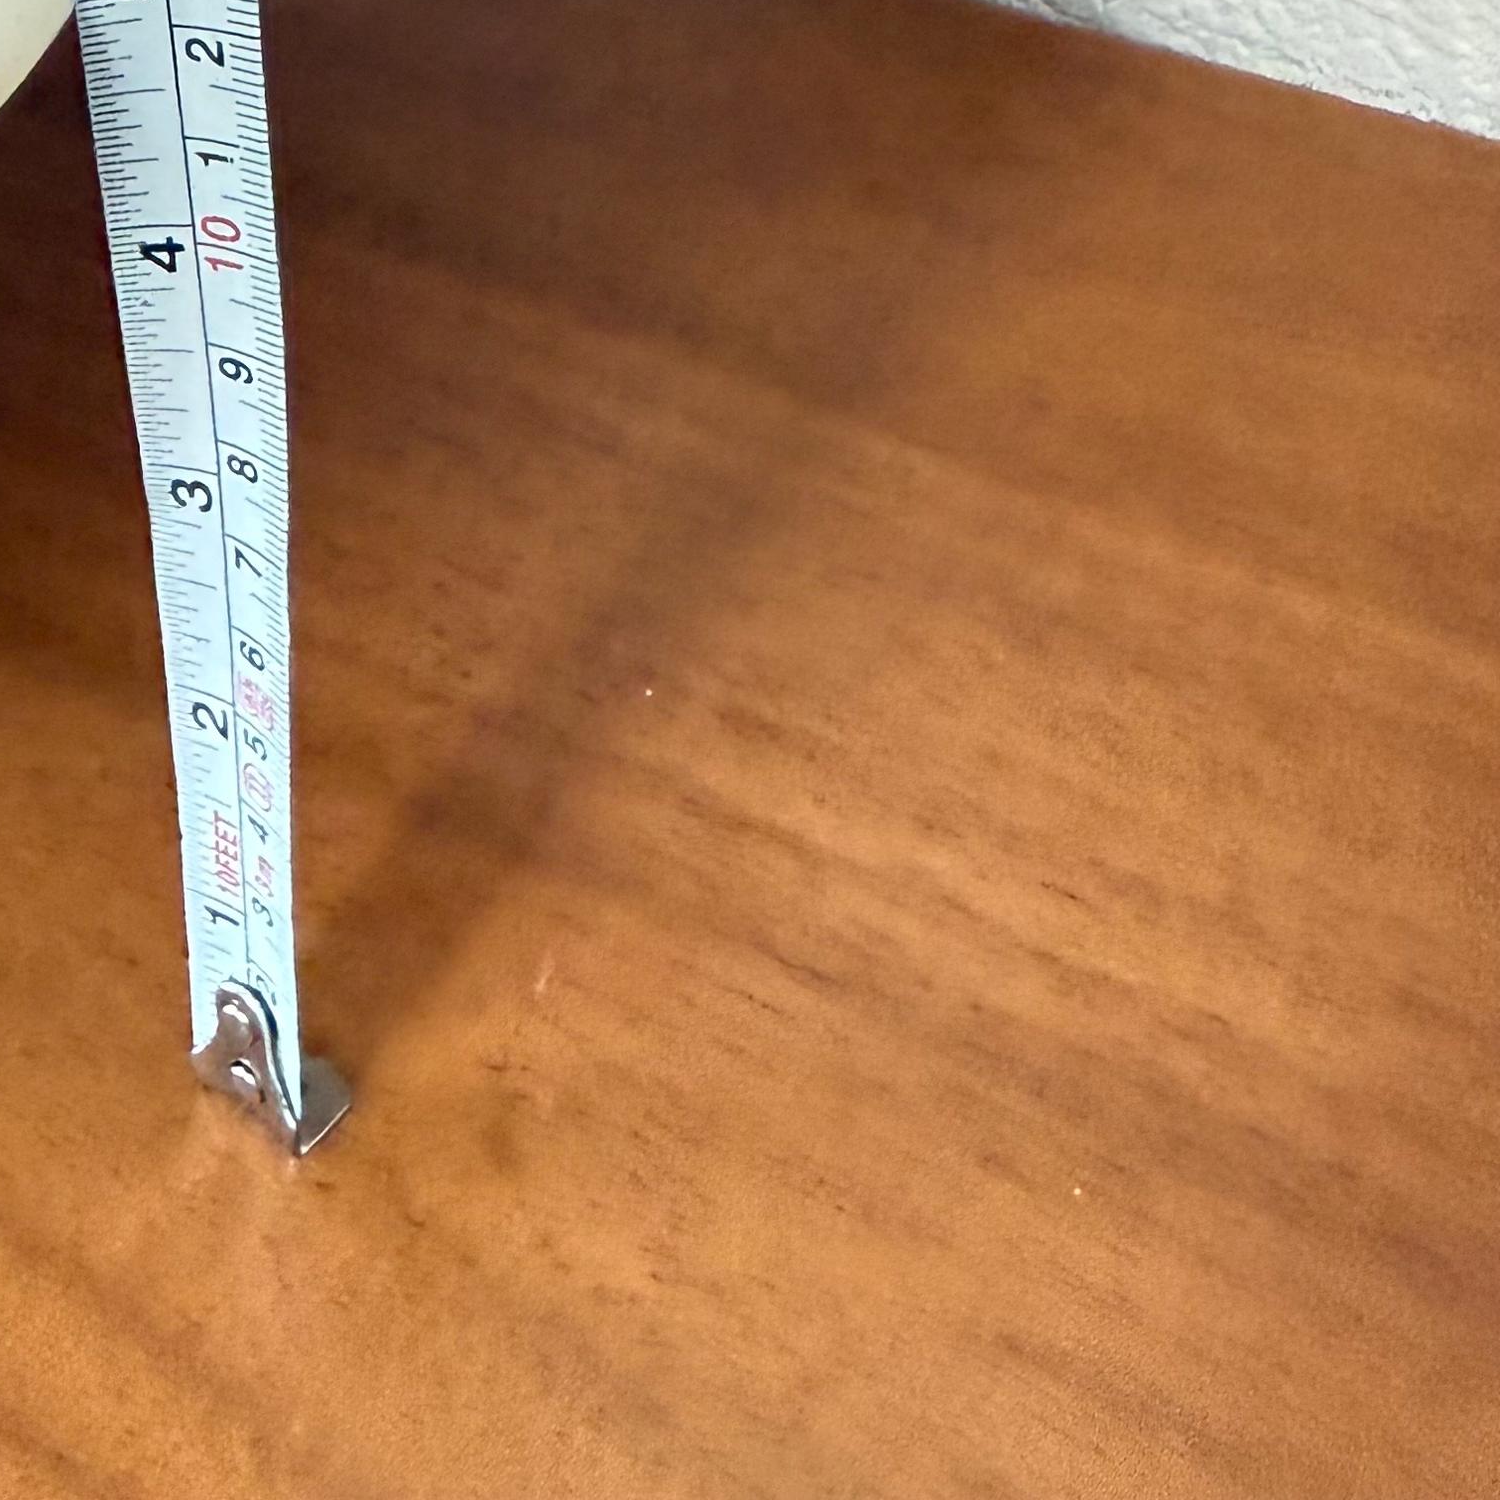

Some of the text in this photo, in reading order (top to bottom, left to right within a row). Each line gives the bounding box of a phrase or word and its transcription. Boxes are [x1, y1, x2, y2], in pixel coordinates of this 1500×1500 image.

[185, 37, 225, 68] 2
[194, 151, 232, 167] 1
[139, 236, 185, 273] 4
[200, 215, 244, 272] 10
[219, 357, 253, 384] 9
[227, 454, 258, 484] 8
[170, 479, 213, 513] 3
[235, 546, 263, 578] 7
[239, 640, 265, 671] 6
[191, 702, 228, 740] 2
[244, 727, 267, 761] 5
[247, 814, 268, 845] 4
[204, 905, 240, 926] 1
